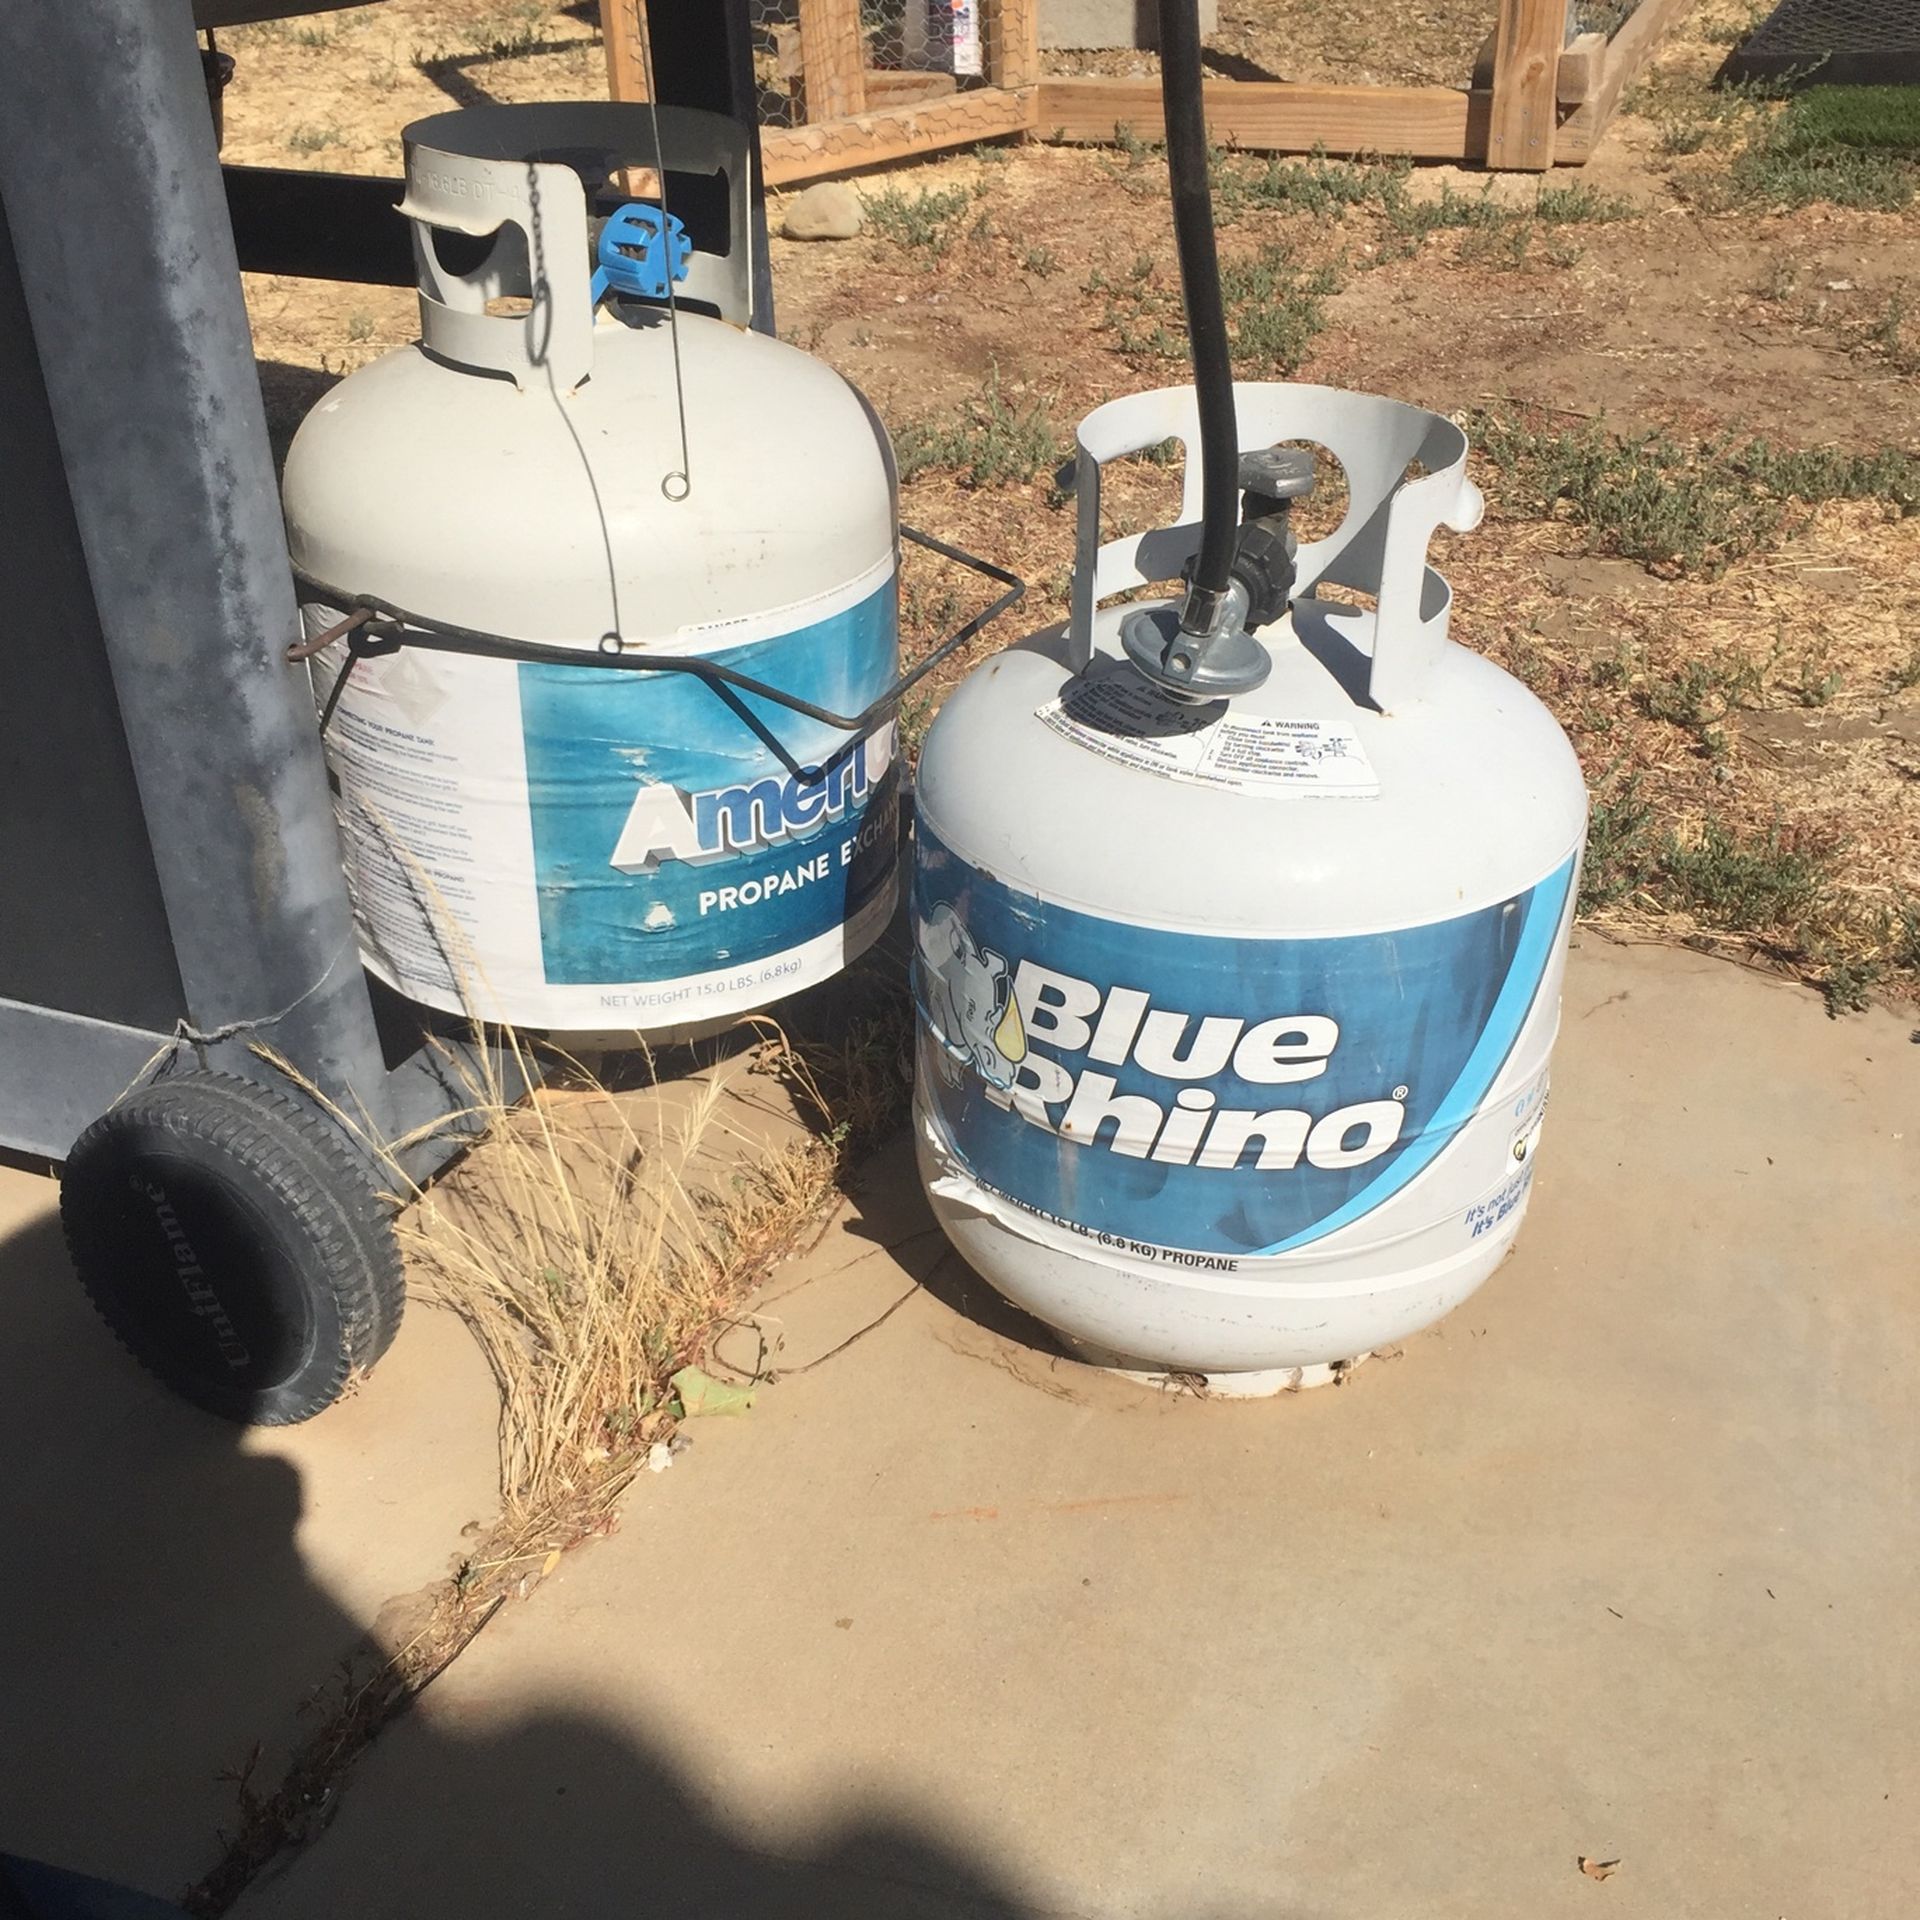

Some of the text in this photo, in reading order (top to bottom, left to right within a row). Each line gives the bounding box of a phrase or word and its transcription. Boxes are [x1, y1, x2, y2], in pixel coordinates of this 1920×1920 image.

[1274, 721, 1320, 730] WARNING
[700, 853, 830, 916] PROPANE
[600, 994, 629, 1007] NET
[633, 986, 692, 1007] WEIGHT
[696, 982, 726, 997] 15.0
[730, 975, 757, 991] LBS.
[1013, 959, 1339, 1084] Blue
[985, 1050, 1405, 1170] Rhino
[1097, 1230, 1126, 1249] (6.8
[1130, 1240, 1157, 1261] KG)
[1162, 1249, 1239, 1272] PROPANE
